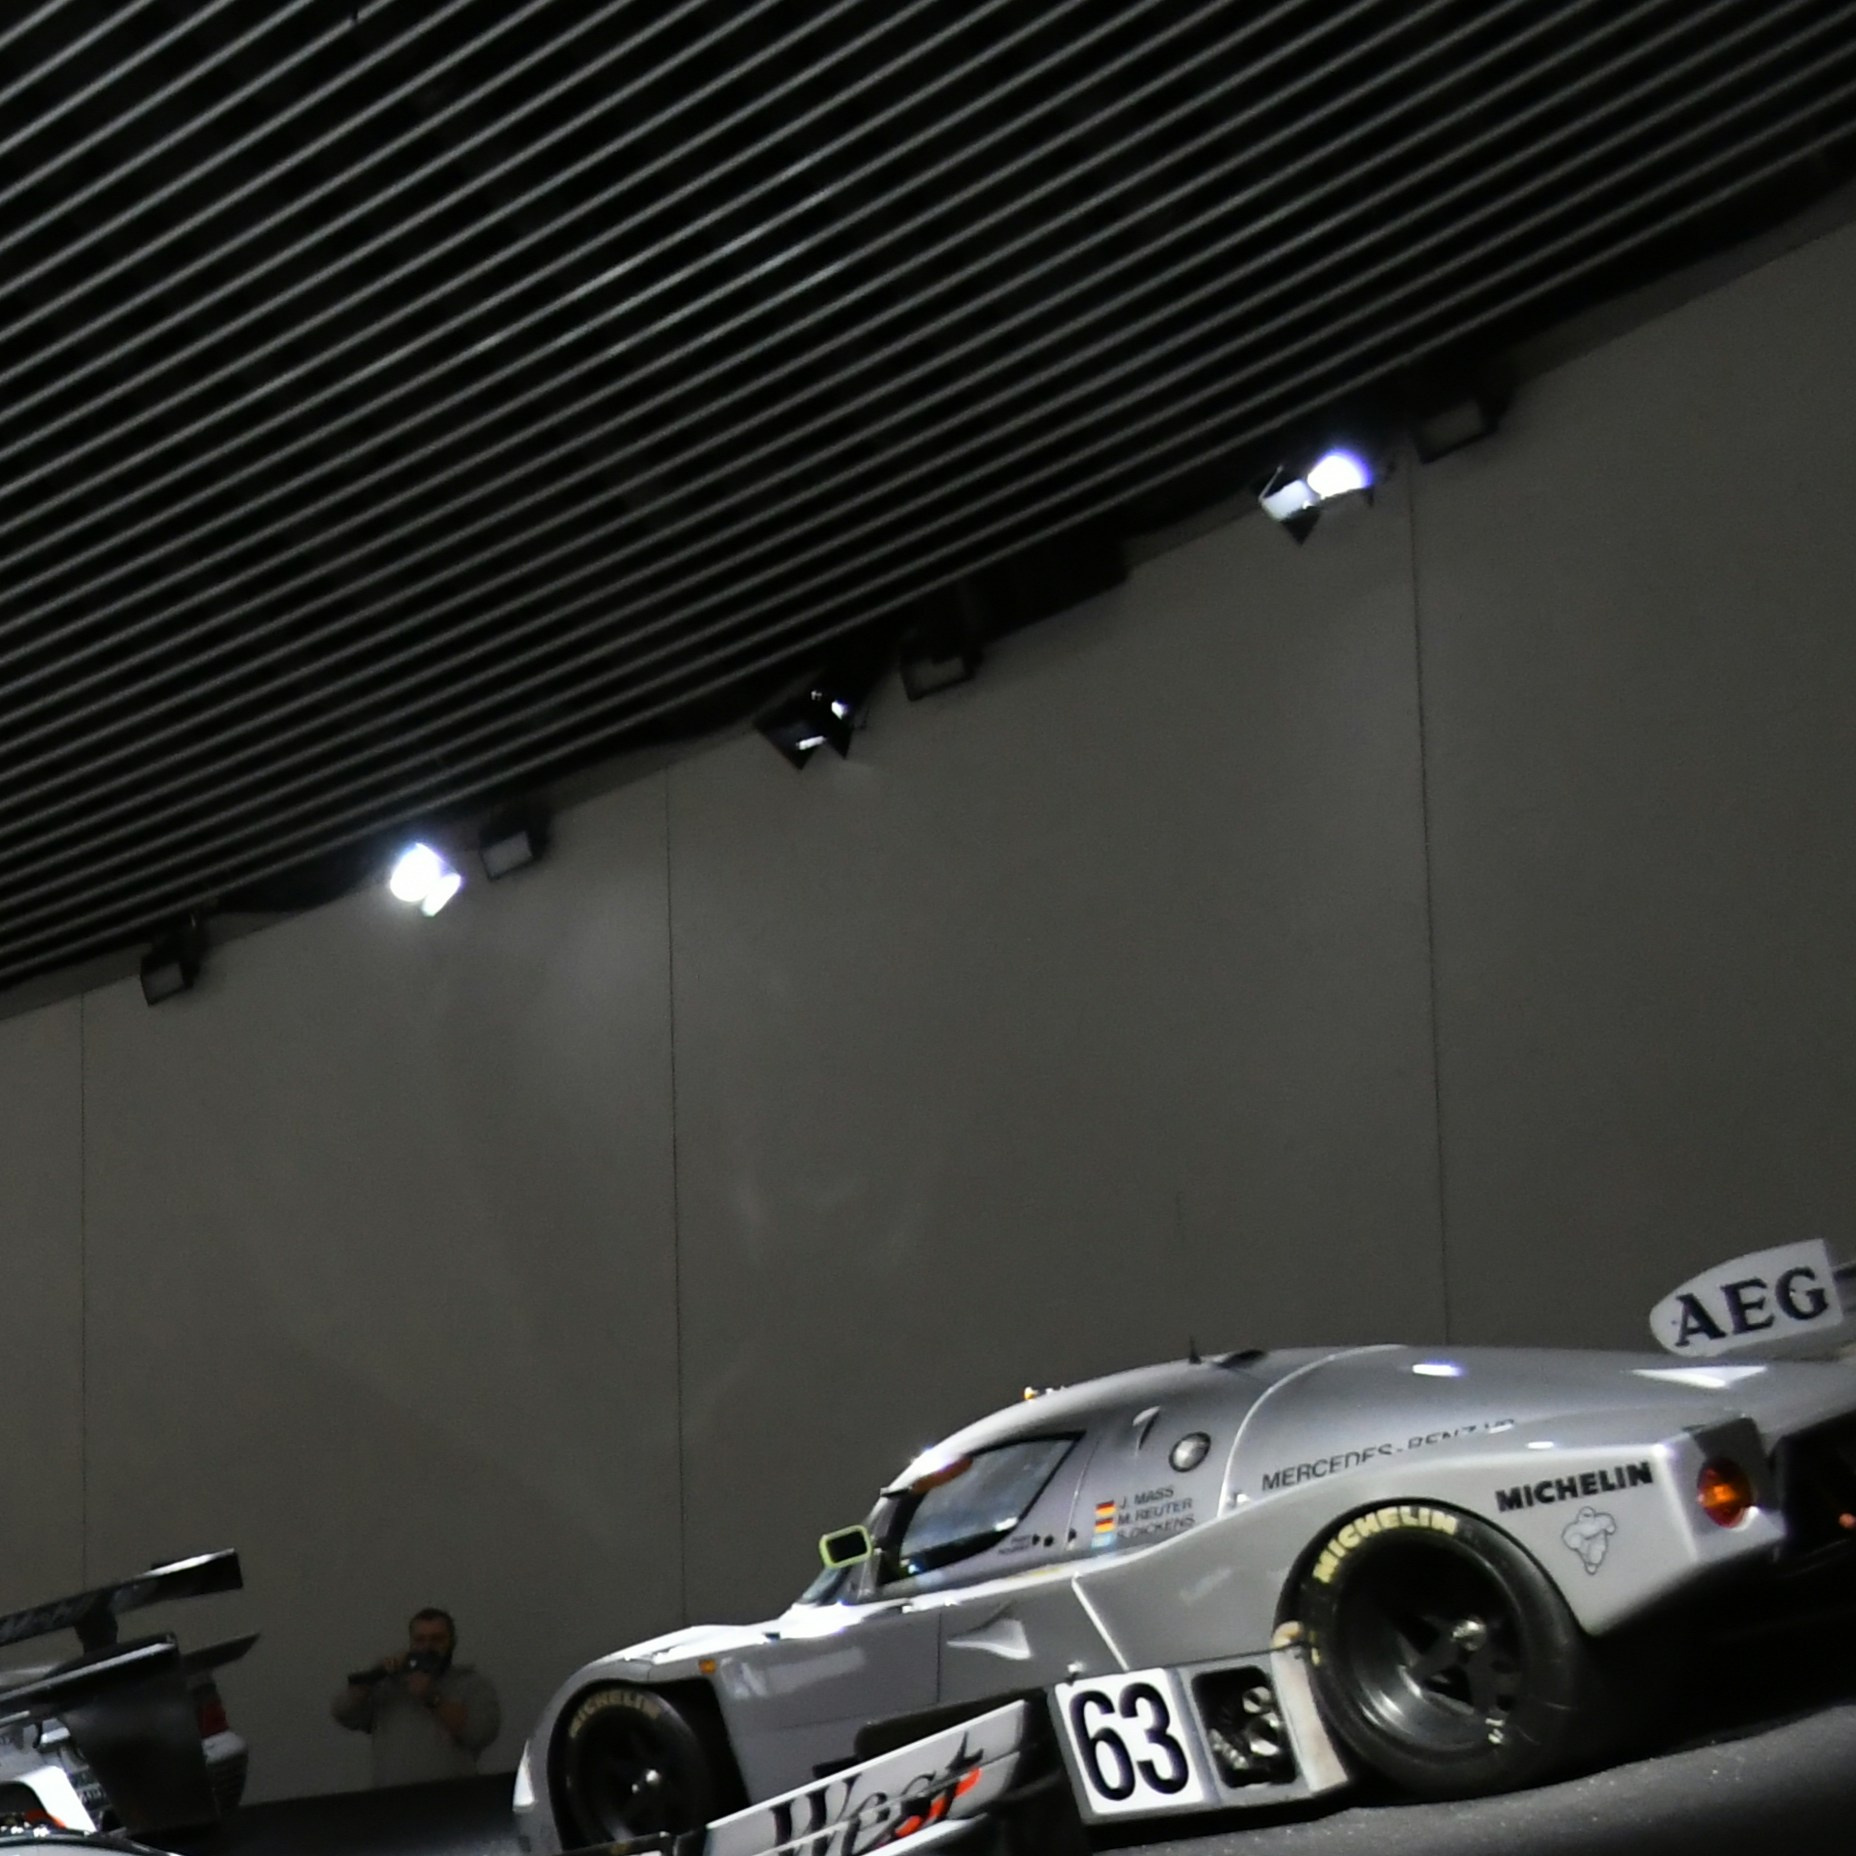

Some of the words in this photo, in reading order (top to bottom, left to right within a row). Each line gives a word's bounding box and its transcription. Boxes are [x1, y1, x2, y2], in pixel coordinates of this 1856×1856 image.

[1672, 1265, 1830, 1348] AEG
[1134, 1486, 1174, 1505] MASS
[1135, 1498, 1193, 1520] REUTER
[1495, 1461, 1654, 1513] MICHELIN
[1312, 1504, 1458, 1585] MICHELIN
[1068, 1681, 1189, 1803] 63
